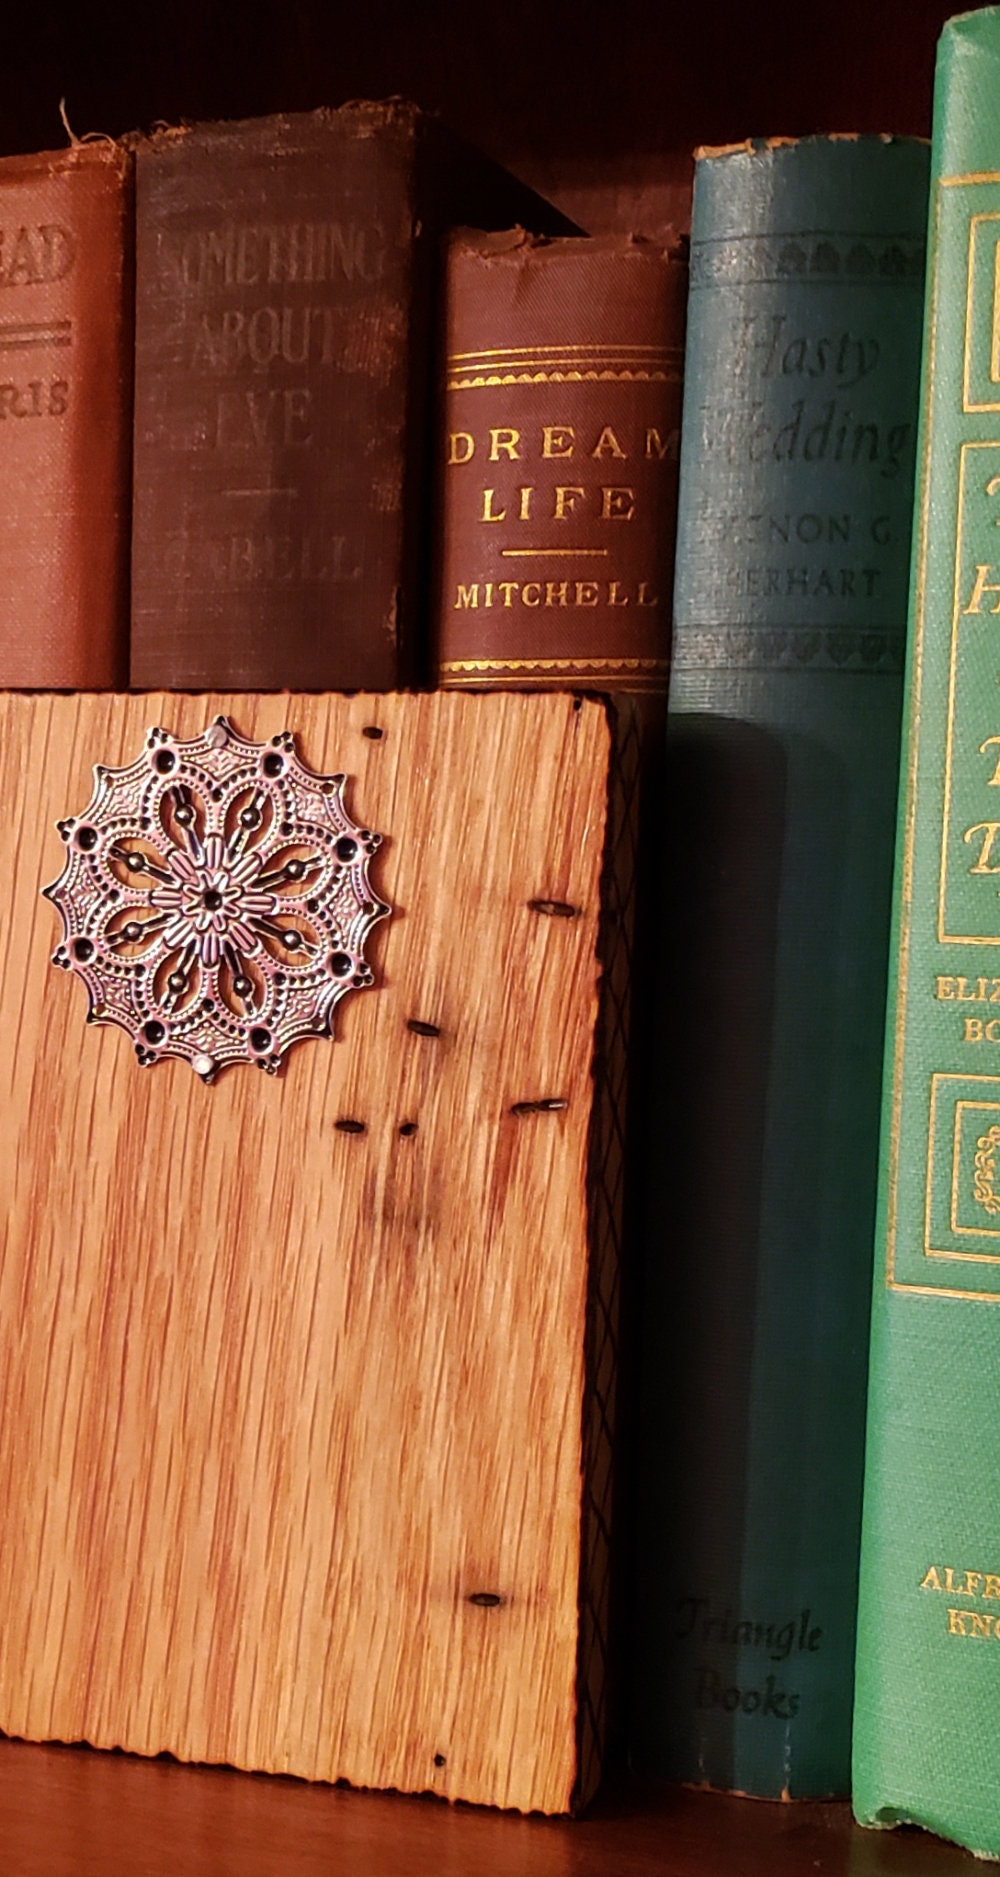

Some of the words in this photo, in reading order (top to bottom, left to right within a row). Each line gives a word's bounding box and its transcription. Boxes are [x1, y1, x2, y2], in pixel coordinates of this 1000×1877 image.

[164, 221, 387, 287] OMETHING
[190, 305, 340, 368] ABOUT
[448, 425, 681, 466] DREAM
[702, 399, 912, 480] edding
[480, 486, 634, 523] LIFE
[454, 581, 660, 608] MITCHELL
[708, 567, 882, 598] ERHART
[675, 1597, 824, 1662] Triangle
[694, 1665, 801, 1721] Books
